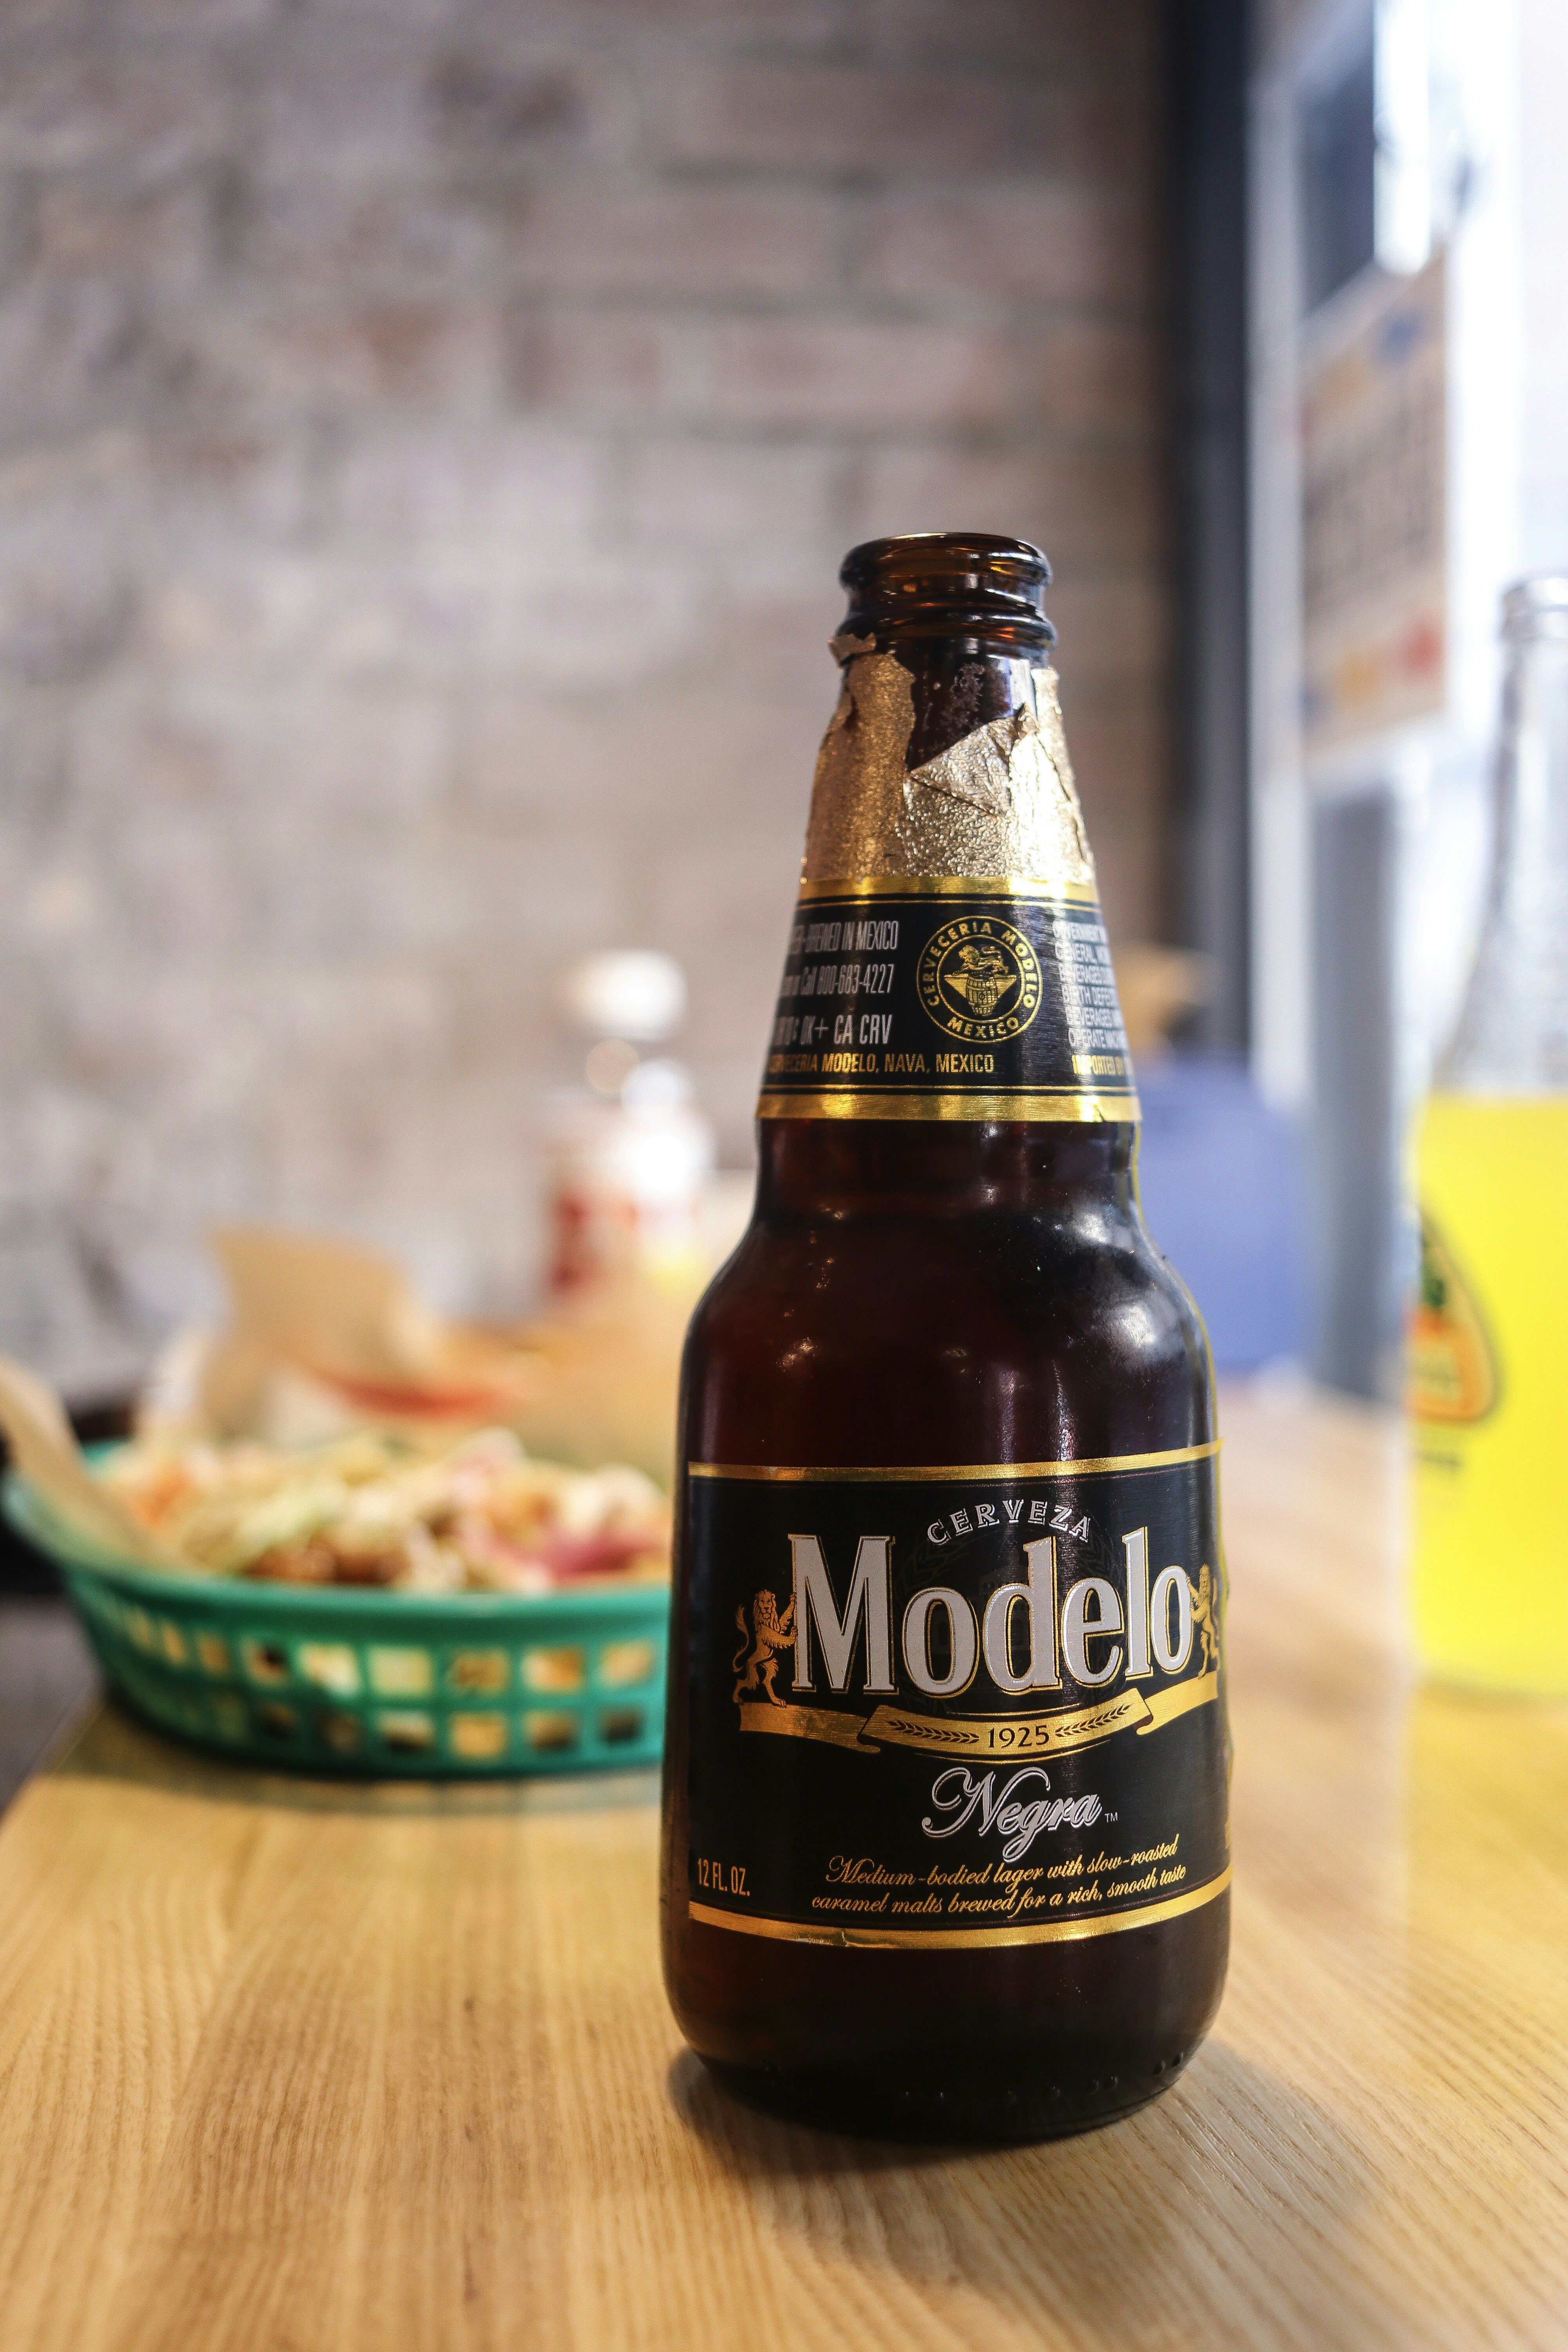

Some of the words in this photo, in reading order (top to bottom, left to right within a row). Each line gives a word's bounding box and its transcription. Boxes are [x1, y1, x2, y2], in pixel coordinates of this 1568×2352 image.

[855, 920, 900, 951] MEXICO
[923, 921, 992, 1007] CERVECERIA
[1001, 930, 1038, 1009] MODELO
[834, 1014, 853, 1045] CA
[859, 1014, 893, 1045] CRV
[947, 1016, 1019, 1038] MEXICO
[822, 1053, 879, 1074] MODELO,
[936, 1053, 994, 1073] MEXICO
[927, 1499, 1090, 1545] CERVEZA
[787, 1526, 1194, 1699] Modelo
[987, 1724, 1050, 1749] 1925
[921, 1766, 1102, 1863] Negra
[697, 1857, 709, 1887] 12
[712, 1862, 728, 1891] FL.
[731, 1866, 750, 1896] OZ.
[826, 1855, 993, 1885] Medium-bodied
[994, 1862, 1044, 1894] lager
[1047, 1854, 1085, 1879] with
[1087, 1833, 1180, 1874] slow-roasted
[812, 1892, 890, 1912] caramel
[891, 1893, 942, 1913] malts
[948, 1889, 1018, 1913] brewed
[1007, 1886, 1045, 1918] for
[1049, 1893, 1063, 1906] a
[1067, 1879, 1102, 1905] rich,
[1106, 1865, 1158, 1897] smooth
[1159, 1864, 1187, 1880] taste
